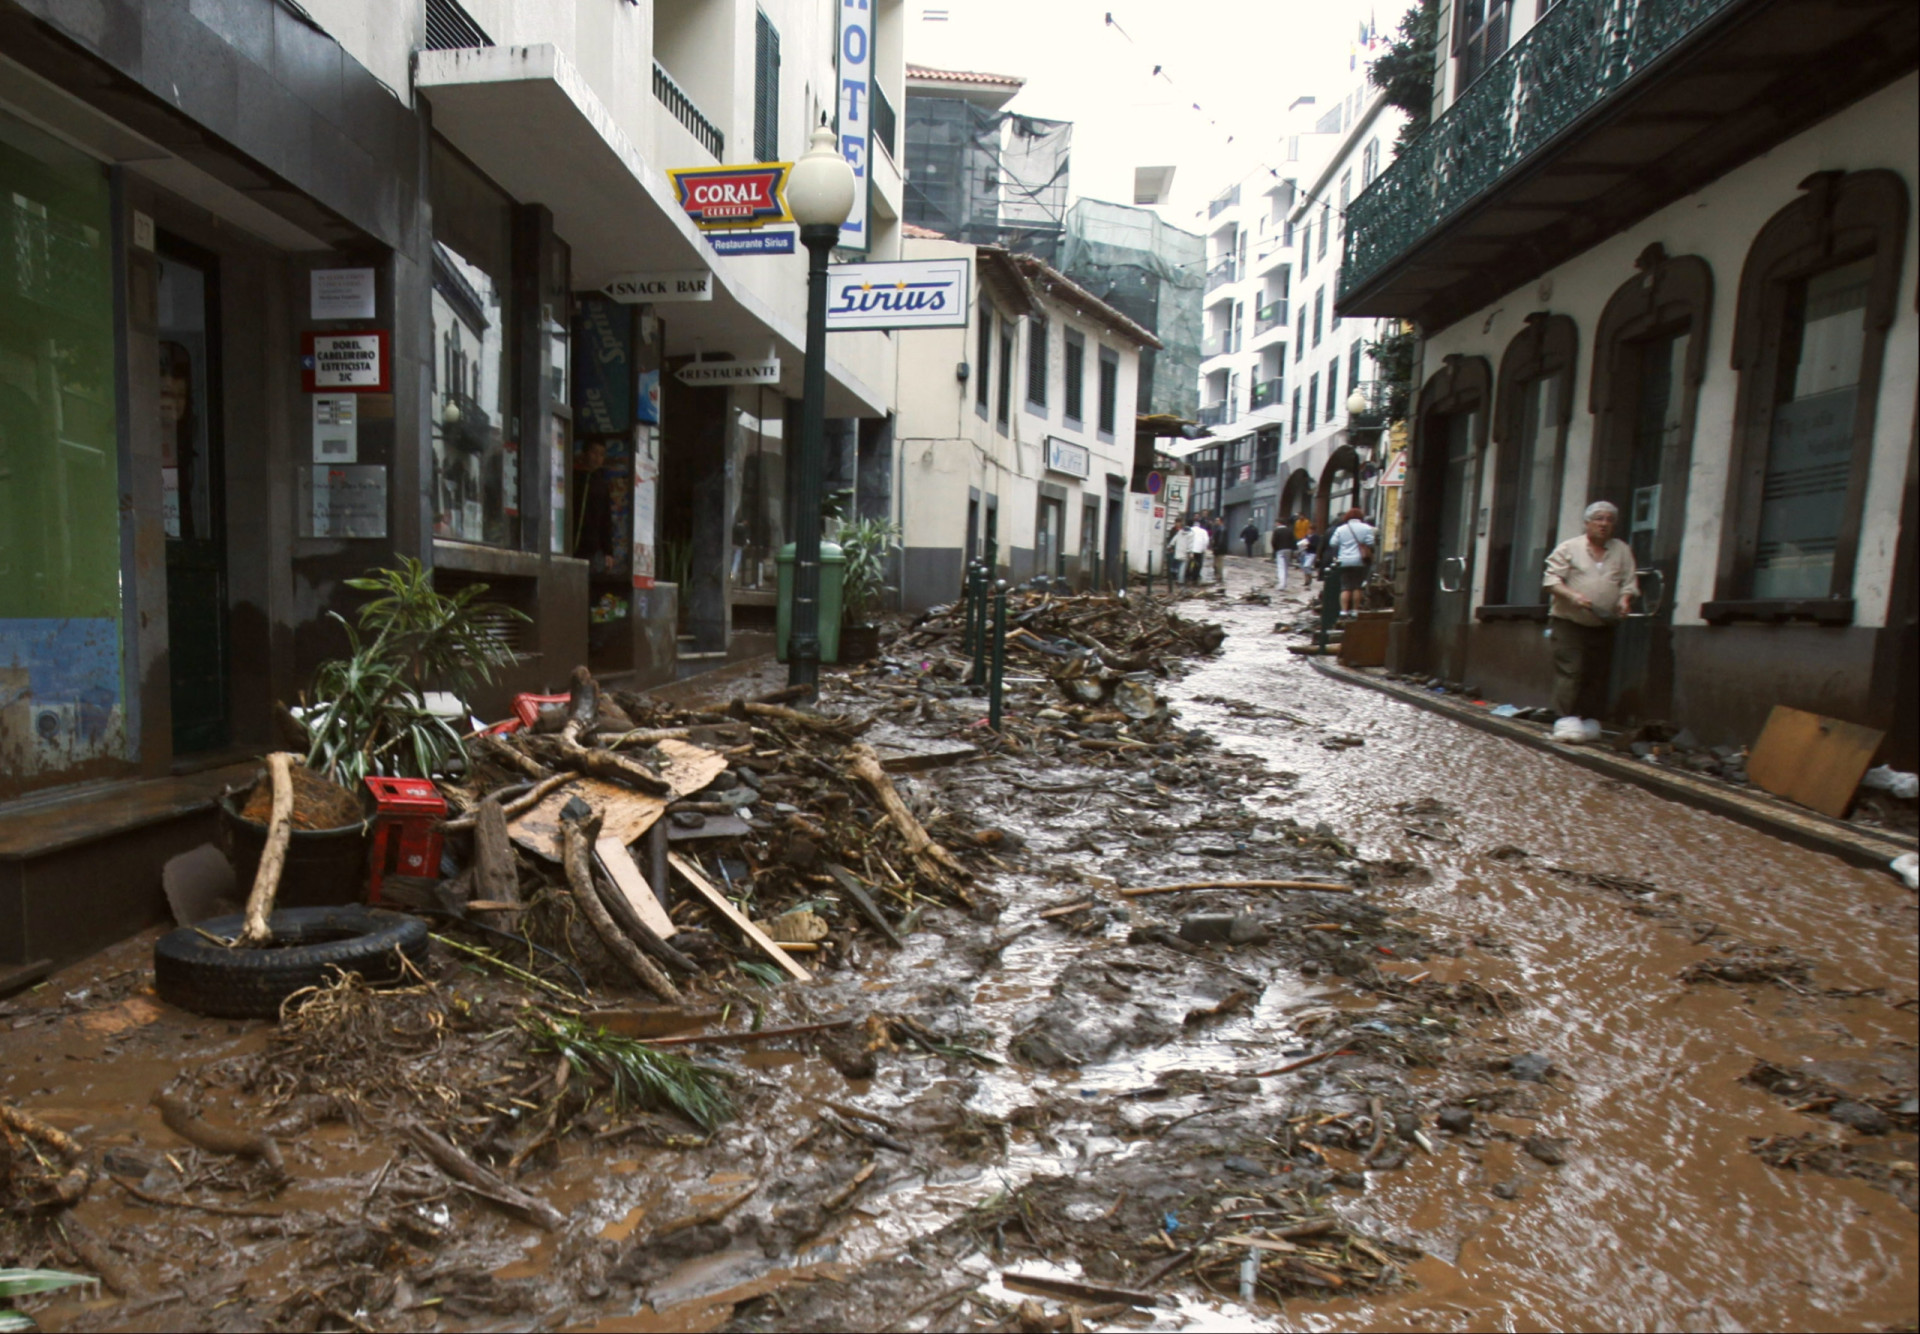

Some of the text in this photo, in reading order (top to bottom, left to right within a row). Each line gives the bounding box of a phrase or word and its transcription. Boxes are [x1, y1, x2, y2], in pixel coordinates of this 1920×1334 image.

[694, 182, 762, 204] CORAL
[707, 207, 749, 217] CERVEJA
[714, 238, 763, 251] Restaurante
[764, 236, 788, 248] Sirius
[616, 279, 707, 295] SNACK BAR
[828, 279, 954, 314] Sirius
[583, 300, 626, 364] Sprite
[332, 341, 361, 350] DOREL
[316, 351, 376, 360] CABELEIREIRO
[321, 362, 371, 371] ESTETICISTA
[686, 366, 777, 379] RESTAURANTE
[338, 372, 352, 382] 2/C
